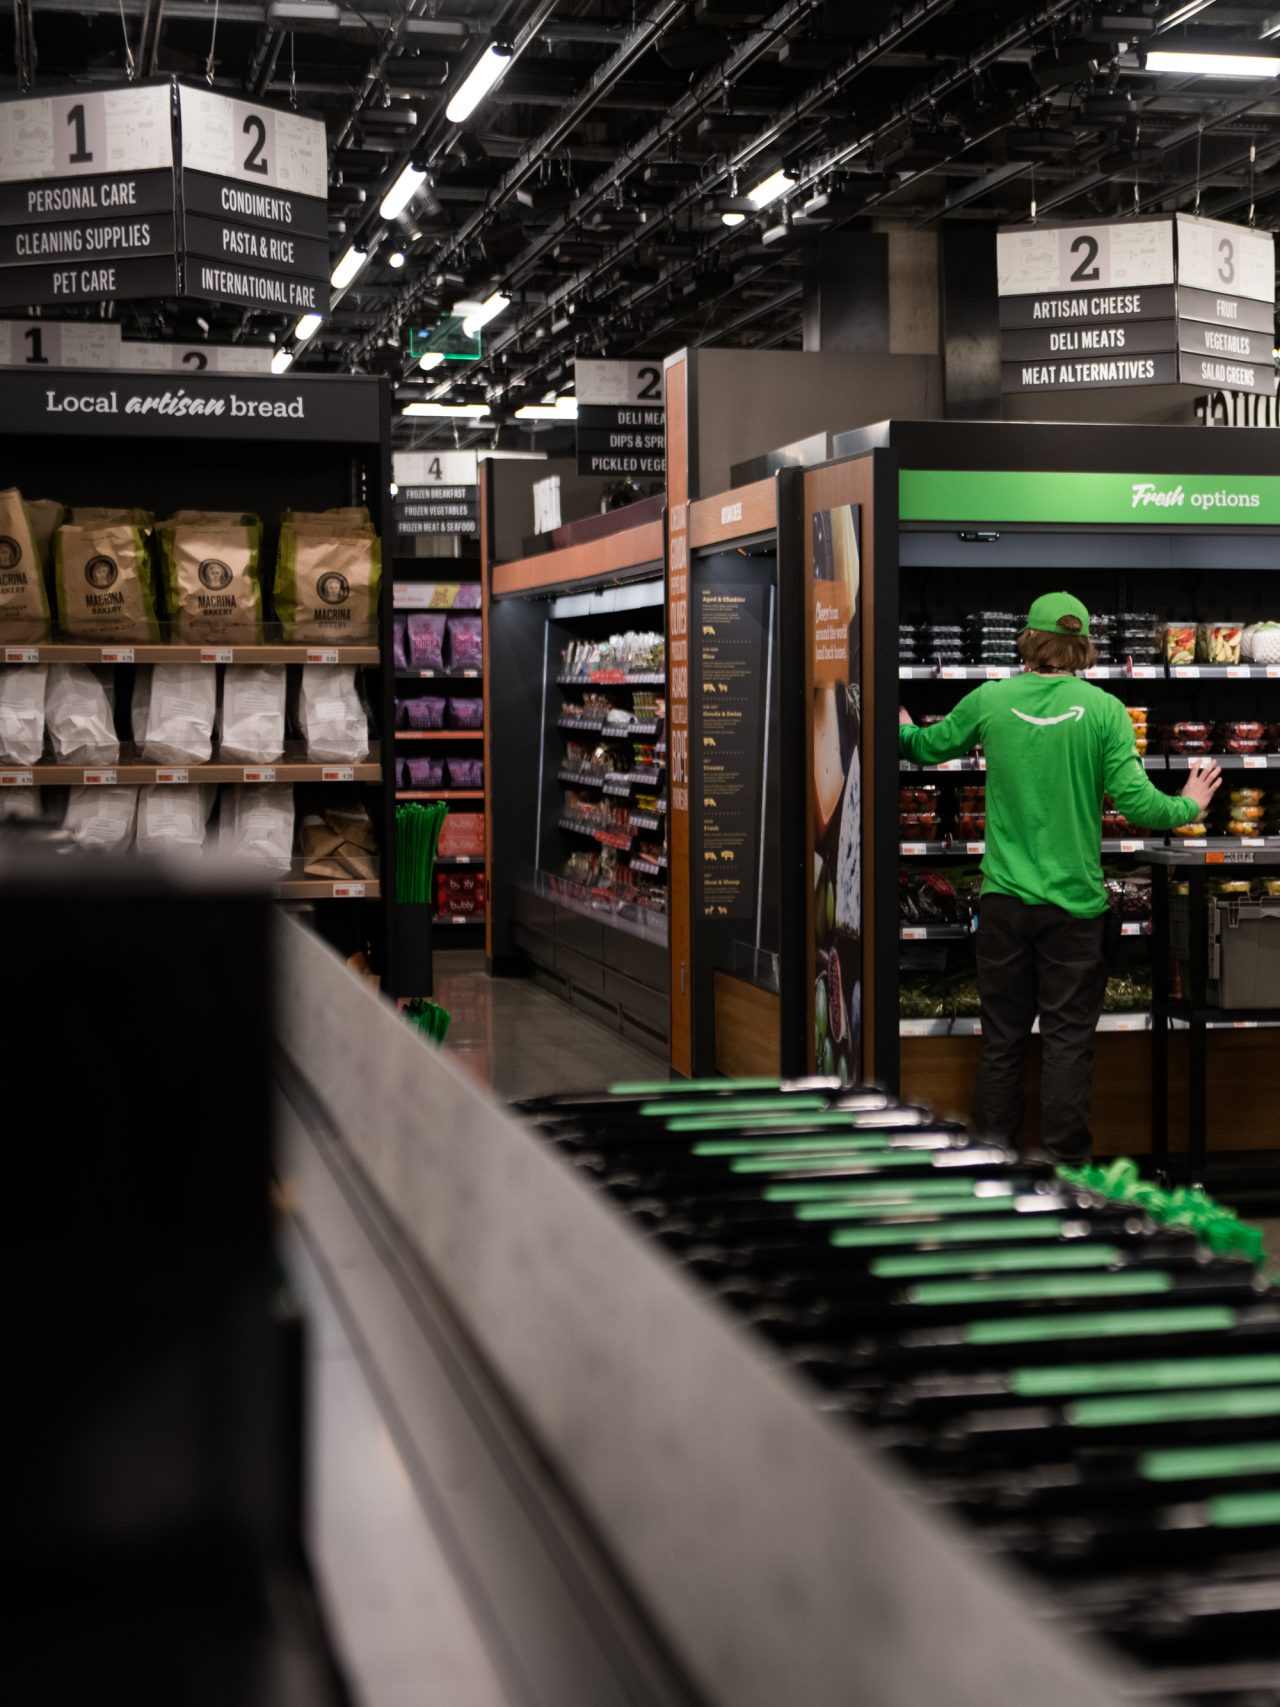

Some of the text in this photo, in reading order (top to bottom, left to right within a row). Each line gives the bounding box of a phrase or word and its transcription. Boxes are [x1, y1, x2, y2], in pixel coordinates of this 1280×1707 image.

[66, 104, 93, 163] 1
[242, 115, 268, 175] 2
[28, 183, 137, 212] PERSONAL CARE
[221, 188, 292, 223] CONDIMENTS
[16, 225, 151, 255] CLEANING SUPPLIES
[223, 229, 295, 263] PASTA & RICE
[1070, 236, 1100, 282] 2
[1218, 239, 1235, 284] 3
[53, 269, 116, 294] PET CARE
[202, 268, 316, 308] INTERNATIONAL FARE
[1033, 295, 1141, 319] ARTISAN CHEESE
[1216, 300, 1238, 319] FRUIT
[24, 327, 48, 364] 1
[1050, 329, 1125, 351] DELI MEATS
[1205, 331, 1250, 355] VEGETABLES
[637, 367, 661, 400] 2
[1022, 360, 1154, 385] MEAT ALTERNATIVES
[1202, 363, 1254, 387] SALAD GREENS
[46, 390, 304, 418] Local artisan bread
[618, 412, 641, 425] DELI
[610, 434, 665, 448] DIPS & SPR
[428, 458, 443, 480] 4
[591, 456, 637, 471] PICKLED
[406, 489, 430, 499] FROZEN
[1132, 483, 1260, 510] Fresh options
[404, 505, 468, 516] FROZEN VEGETABLES
[398, 522, 422, 533] FROZEN
[0, 573, 28, 586] ACRINA
[86, 592, 125, 607] MACRINA
[198, 595, 236, 609] MACRINA
[314, 608, 351, 621] MACRINA
